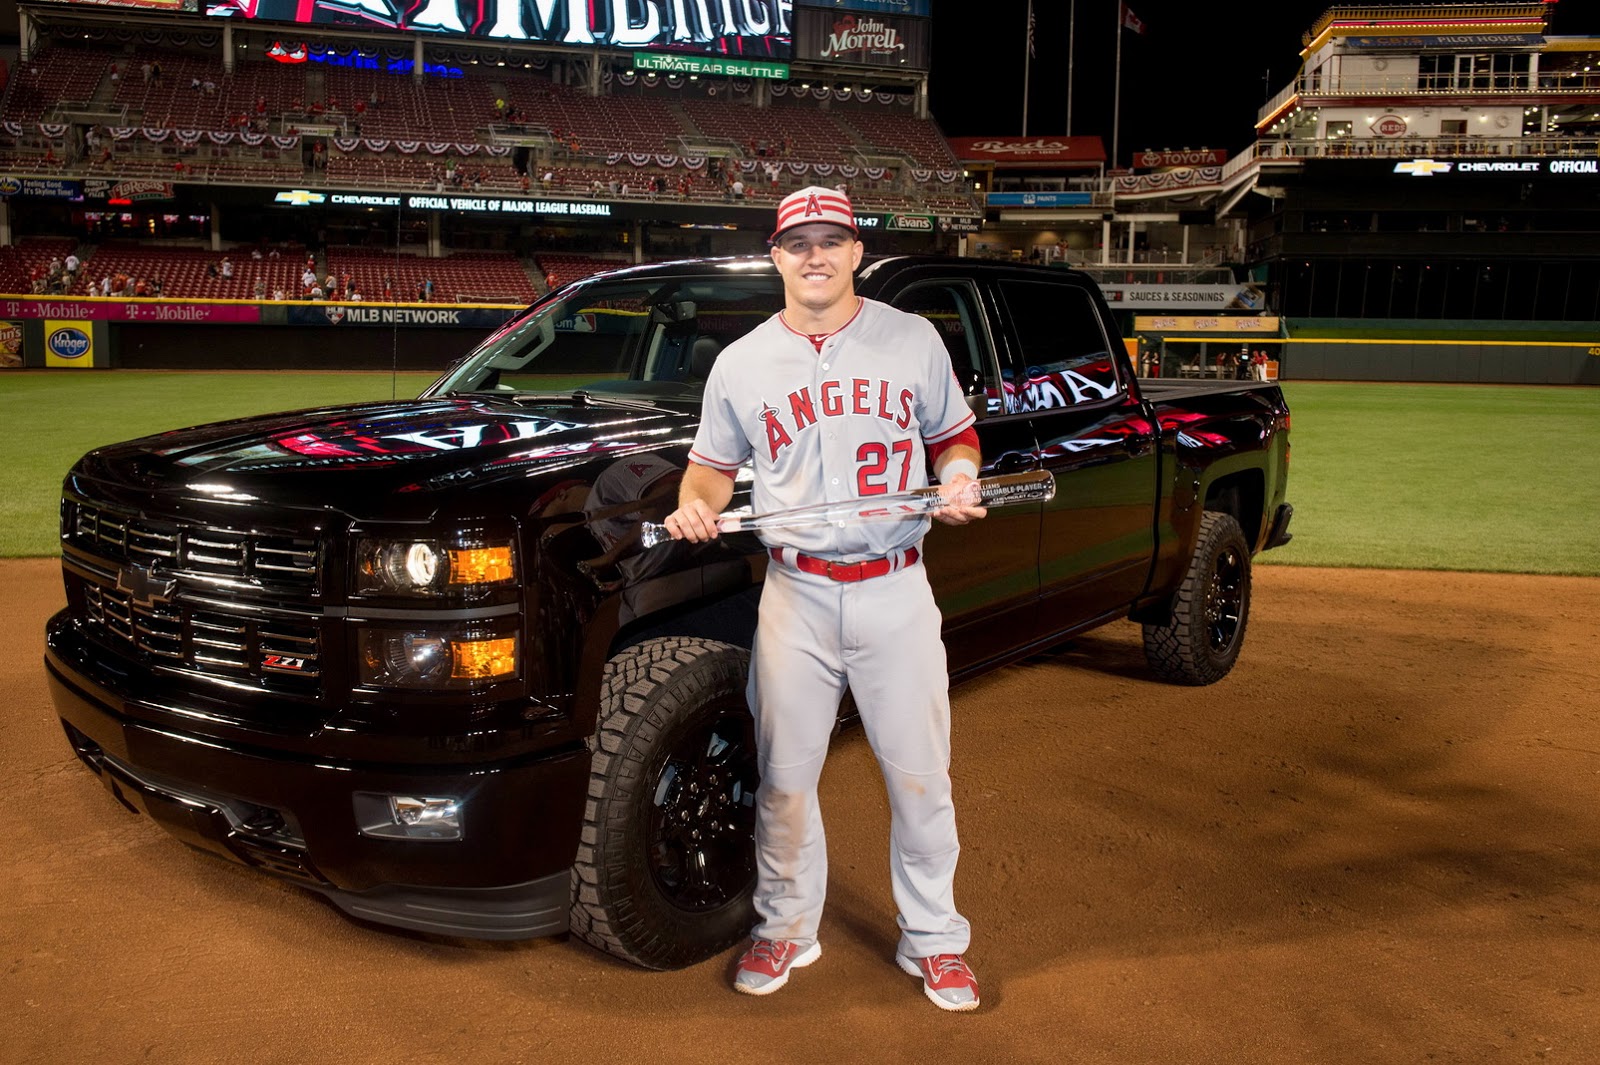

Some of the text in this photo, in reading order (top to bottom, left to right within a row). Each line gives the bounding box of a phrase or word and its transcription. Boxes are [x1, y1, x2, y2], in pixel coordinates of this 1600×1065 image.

[852, 18, 884, 33] John
[821, 29, 905, 57] Morrell
[636, 59, 786, 79] ULTIMATE AIR SHUTTLE
[1381, 124, 1405, 132] REDS
[970, 139, 1069, 153] Reds
[1162, 152, 1217, 164] TOYOTA
[1457, 160, 1599, 174] CHEVROLET OFFICIAL
[331, 194, 611, 216] CHEVROLET OFFICIAL VEHICLE OF MAJOR LEAGUE BASEBALL
[805, 192, 823, 217] A
[853, 217, 878, 227] 11:47
[897, 217, 930, 229] Evans
[1130, 292, 1162, 301] SAUCES
[1163, 292, 1169, 301] &
[1172, 292, 1224, 302] SEASONINGS
[347, 308, 461, 324] MLB NETWORK
[54, 332, 87, 354] Kroger
[760, 378, 914, 463] ANGELS
[856, 438, 914, 497] 27
[981, 486, 1014, 497] VALUABLE
[1015, 483, 1042, 494] PLAYER
[261, 653, 305, 669] Z71
